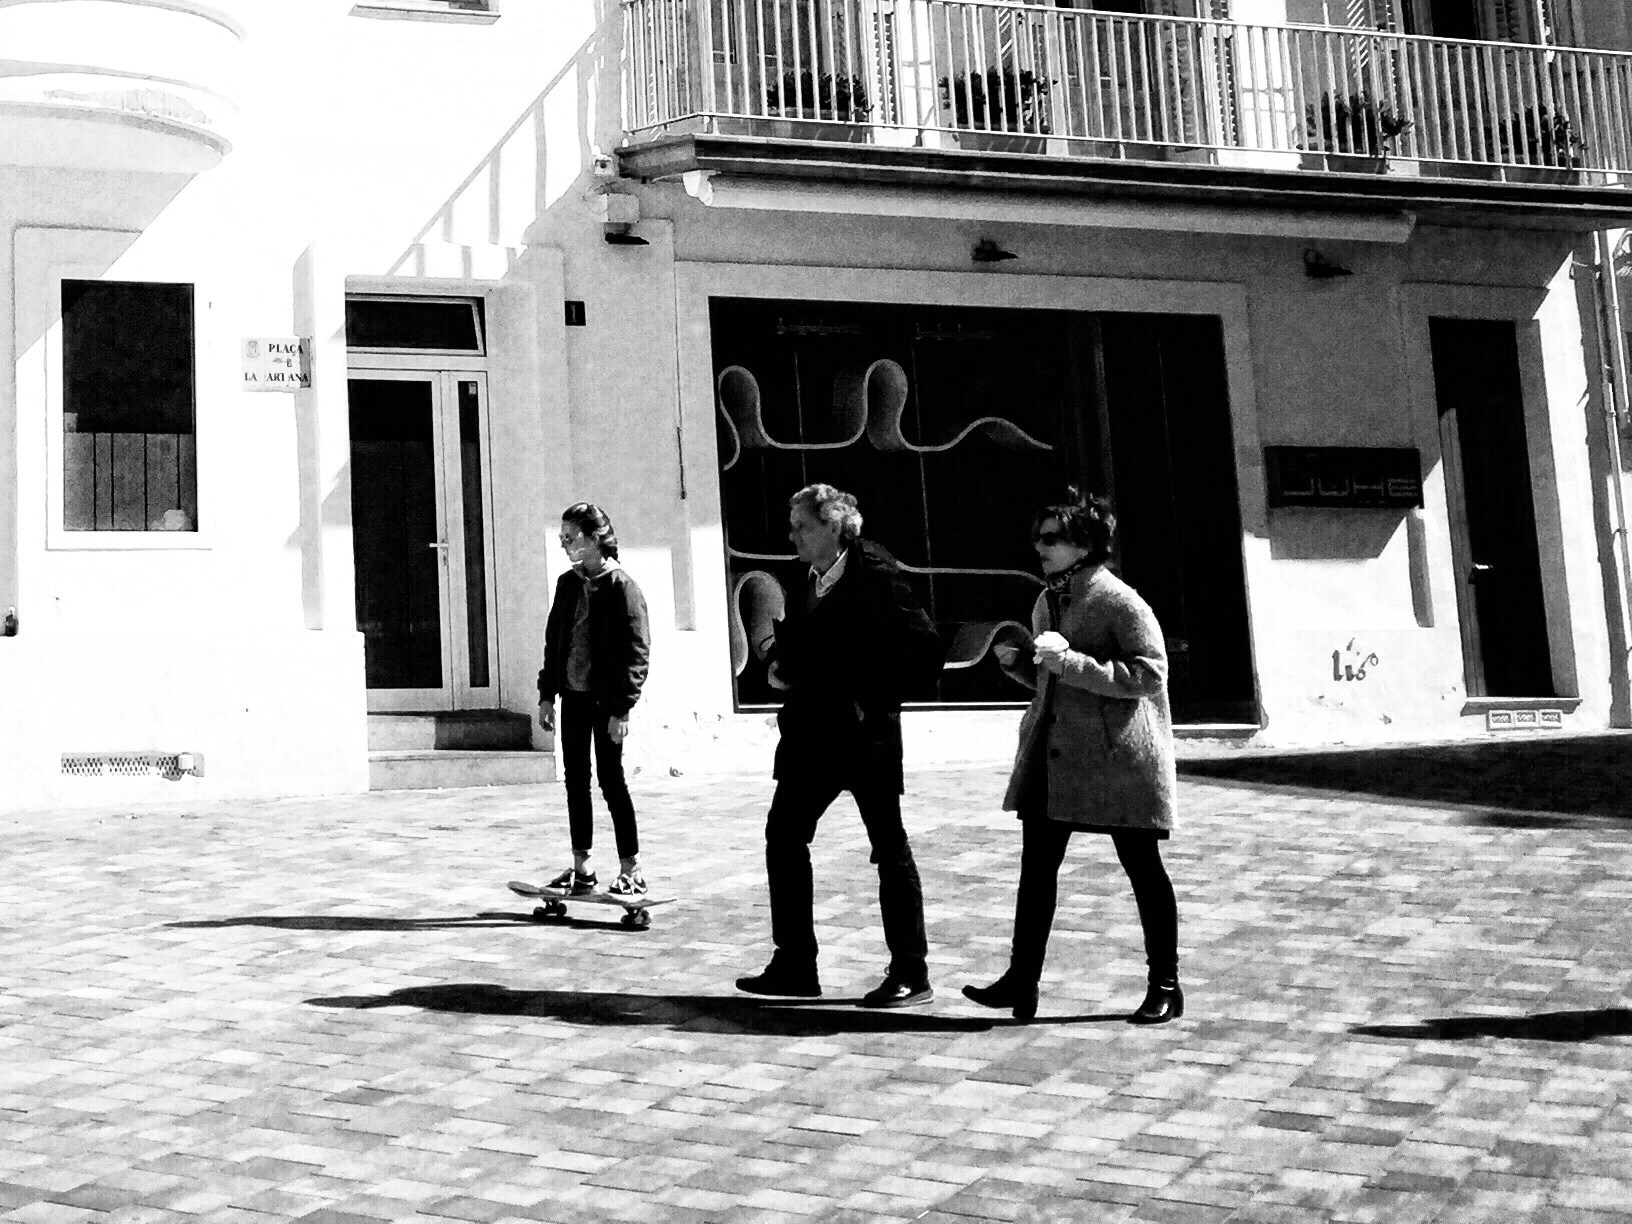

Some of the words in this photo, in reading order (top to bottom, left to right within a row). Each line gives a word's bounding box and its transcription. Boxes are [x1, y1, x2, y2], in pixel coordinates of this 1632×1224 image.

[570, 304, 577, 323] 1
[268, 343, 304, 357] PLAÇA
[244, 372, 258, 382] LA
